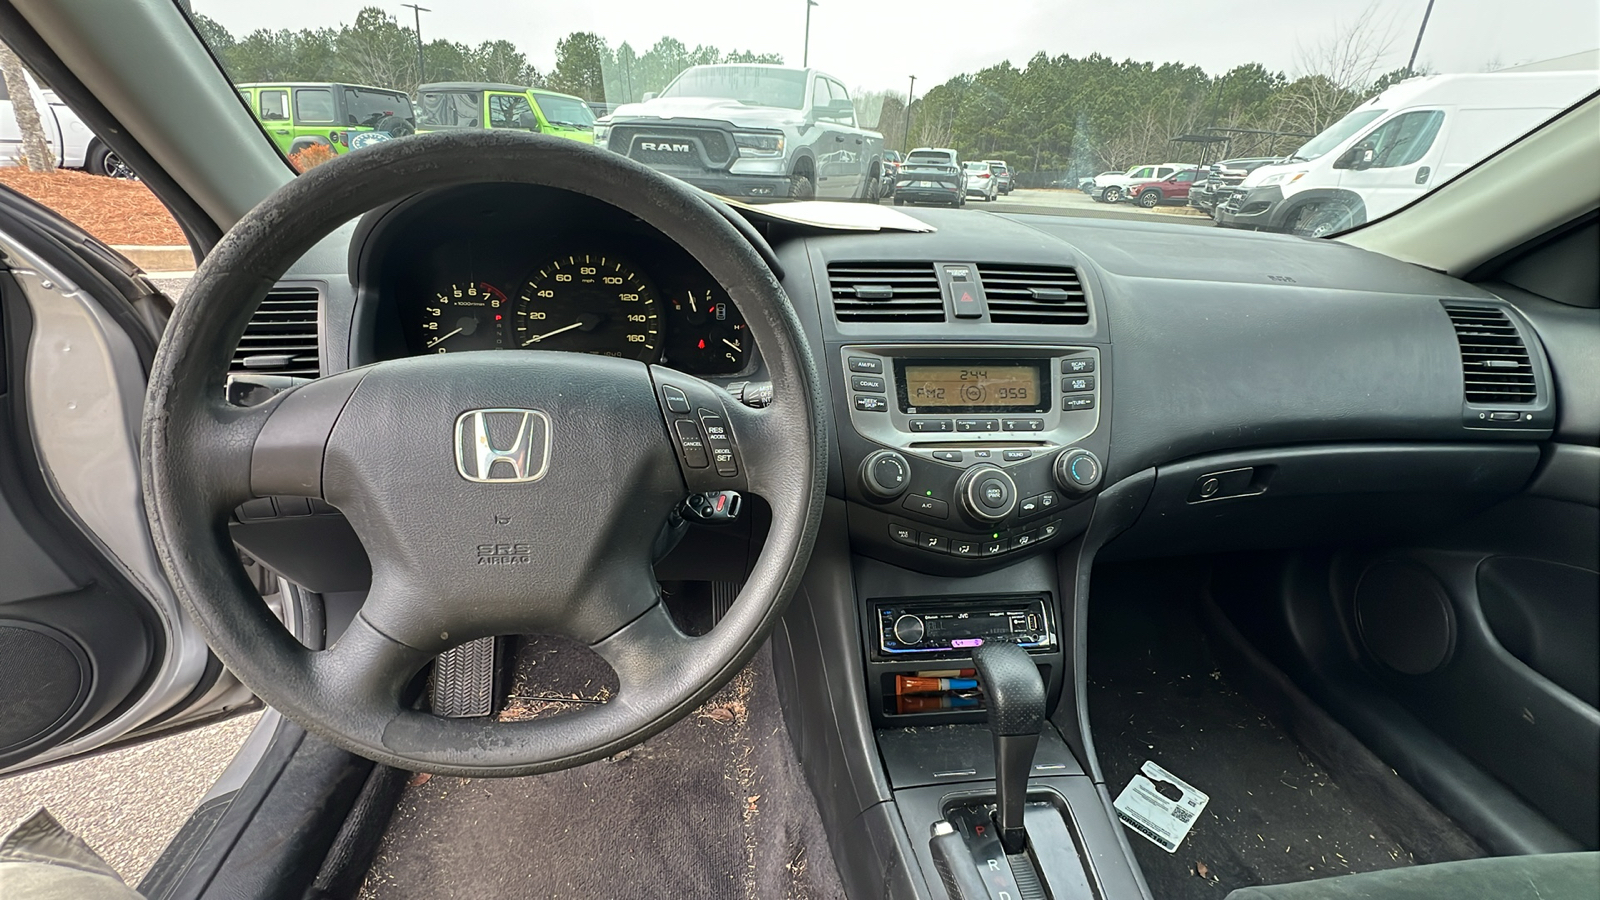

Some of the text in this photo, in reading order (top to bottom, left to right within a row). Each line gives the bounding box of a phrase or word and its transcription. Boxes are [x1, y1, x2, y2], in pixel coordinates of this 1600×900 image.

[641, 142, 689, 152] RAM
[580, 267, 596, 275] 80
[556, 274, 572, 282] 60
[602, 277, 623, 285] 100
[454, 290, 462, 298] 5
[468, 288, 477, 296] 6
[537, 290, 554, 298] 40
[440, 296, 448, 304] 4
[491, 300, 500, 308] 8
[432, 308, 441, 316] 3
[530, 312, 546, 320] 20
[627, 314, 646, 322] 140
[429, 322, 438, 330] 2
[917, 388, 946, 399] FM2
[708, 426, 724, 434] RES
[717, 454, 732, 462] SET
[477, 544, 531, 555] SRS
[477, 556, 531, 564] AIRBAG
[975, 825, 985, 837] P
[987, 859, 1000, 871] R
